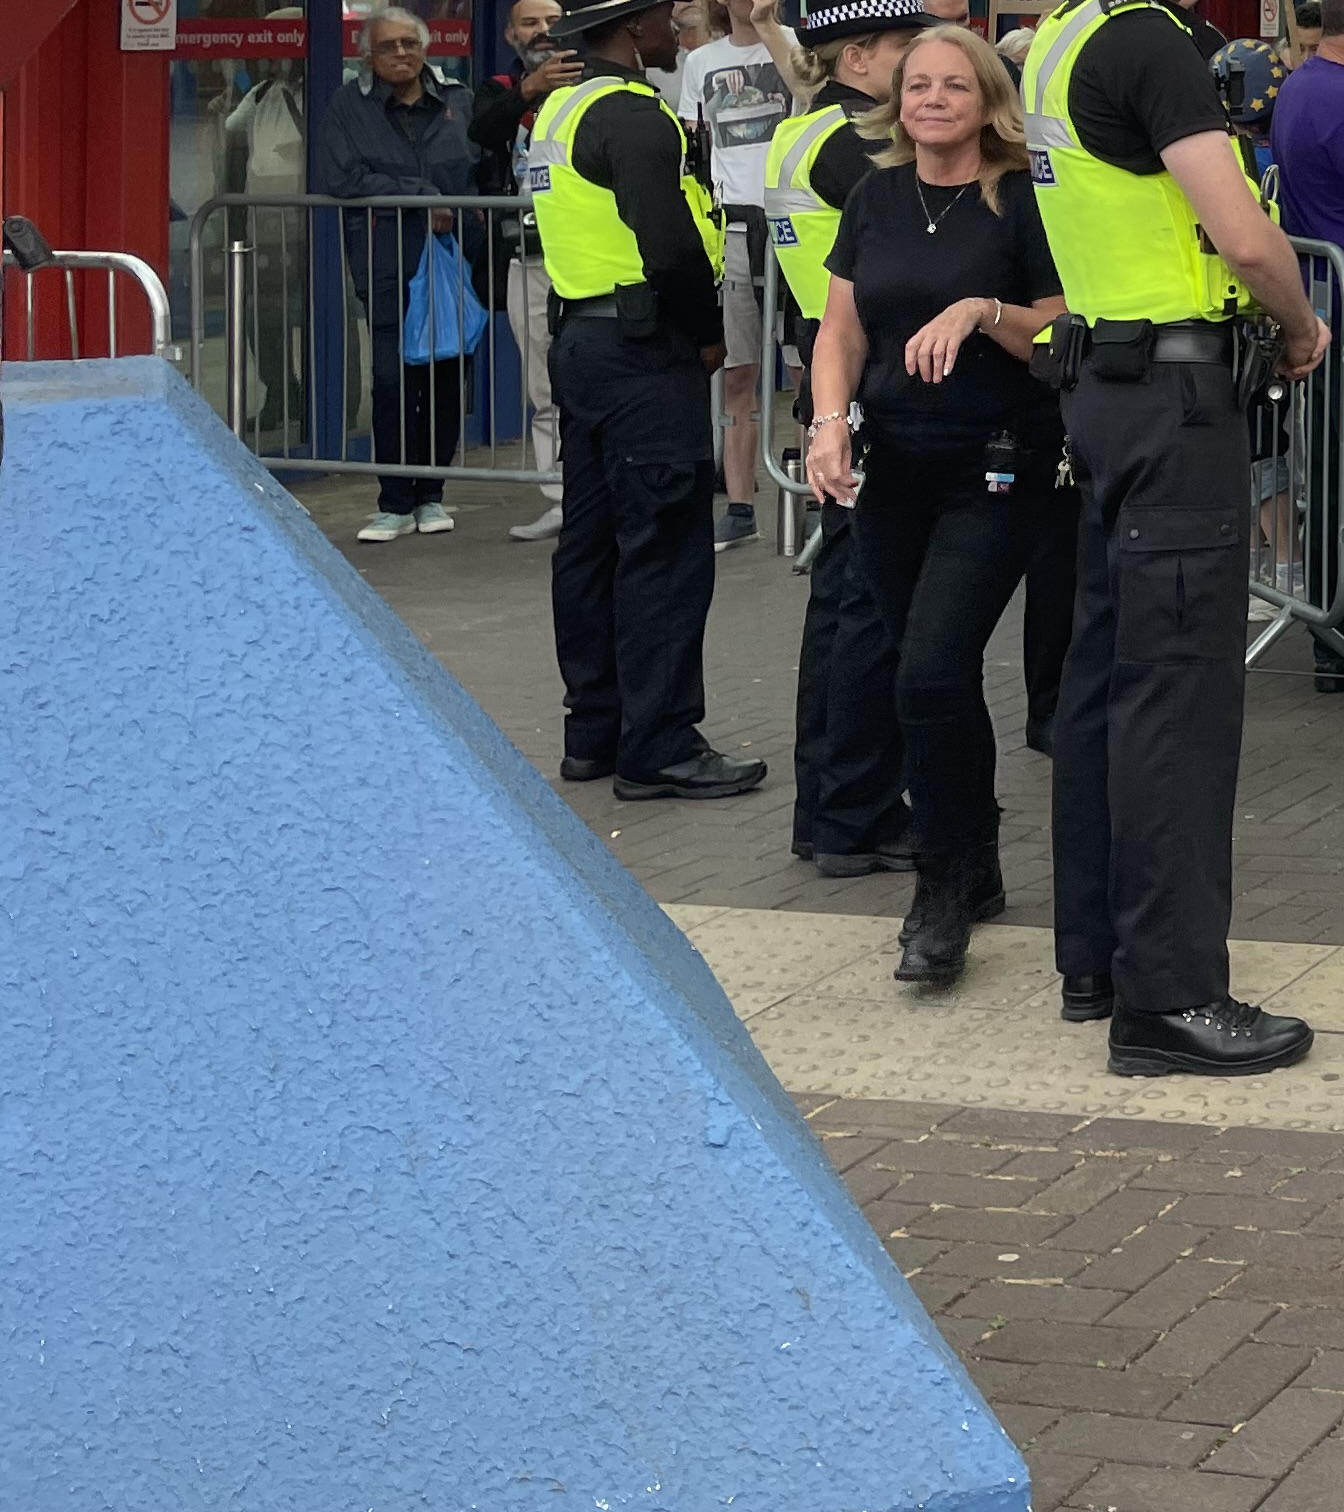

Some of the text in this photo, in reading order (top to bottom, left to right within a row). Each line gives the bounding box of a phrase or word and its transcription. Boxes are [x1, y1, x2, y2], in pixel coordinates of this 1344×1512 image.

[175, 31, 243, 48] mergency
[248, 31, 273, 44] exit
[277, 29, 305, 47] only
[445, 30, 469, 46] only
